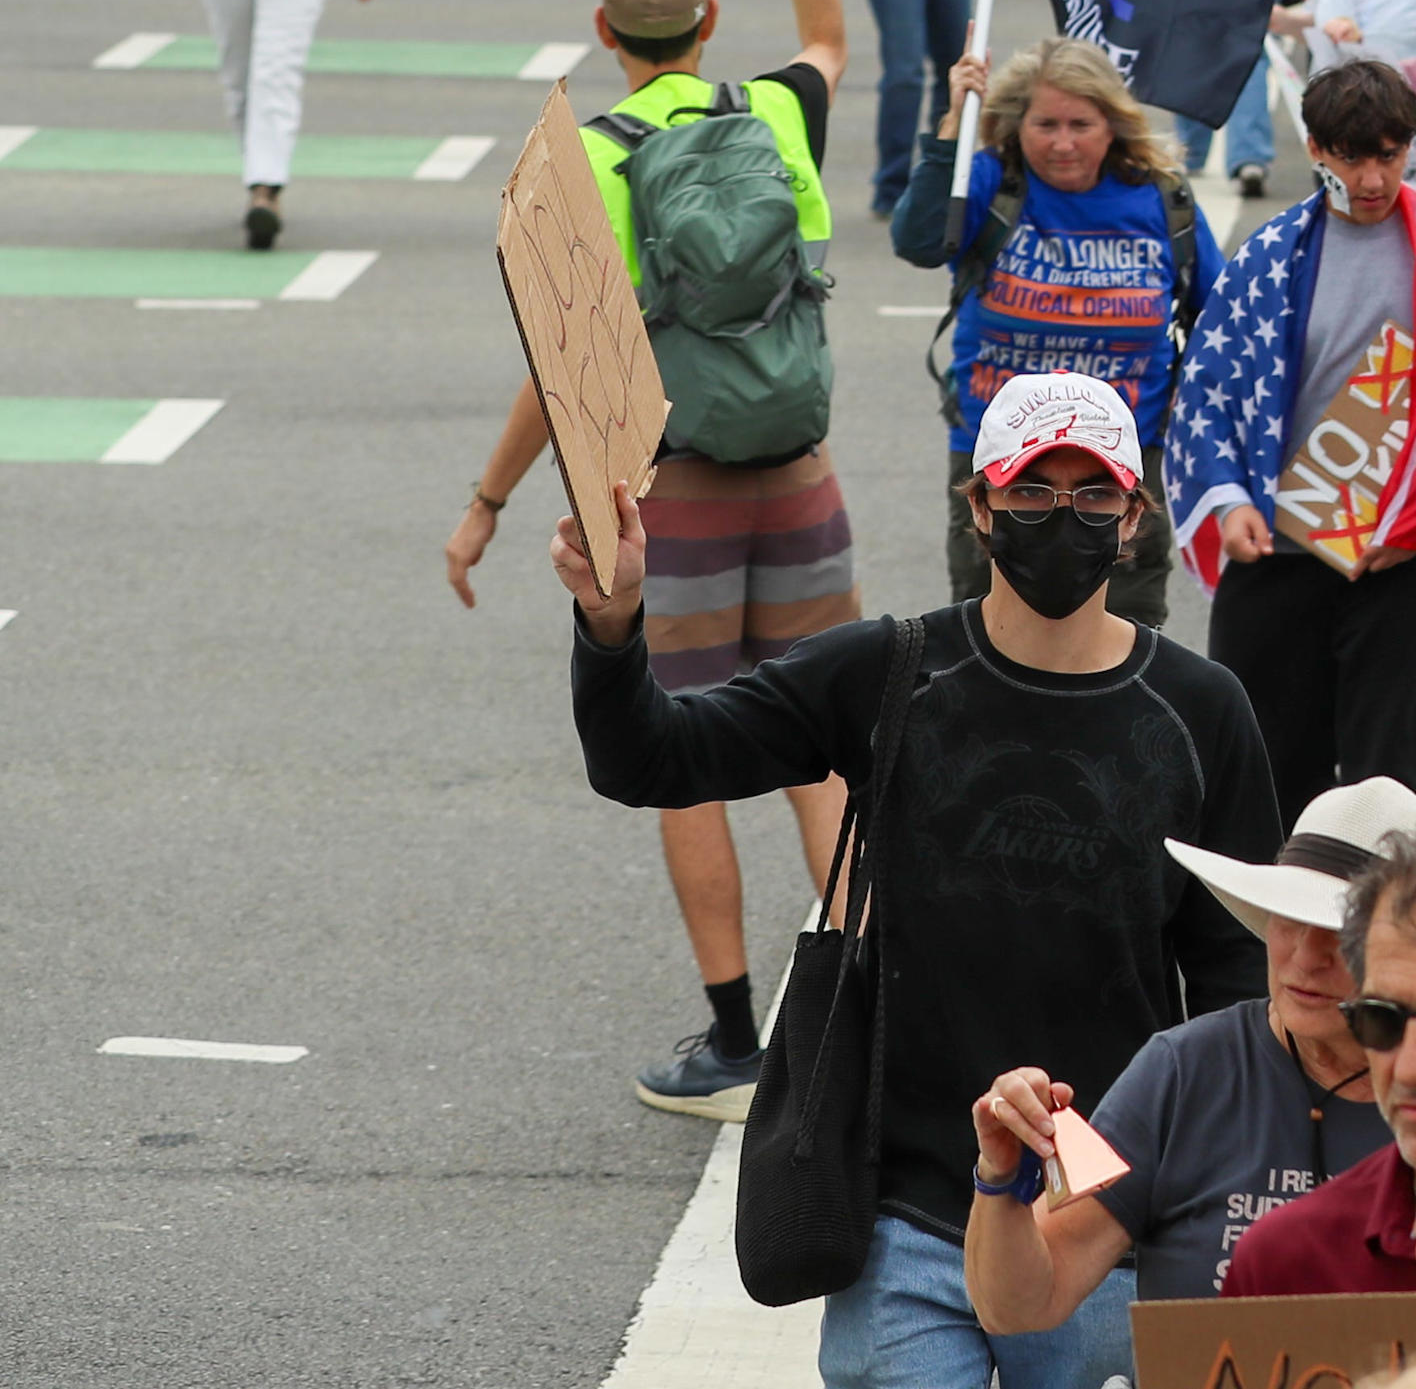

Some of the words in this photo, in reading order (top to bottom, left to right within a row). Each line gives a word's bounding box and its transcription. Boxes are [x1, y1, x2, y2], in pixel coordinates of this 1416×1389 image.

[1033, 236, 1066, 267] NO
[1067, 237, 1165, 270] LONGER
[1031, 266, 1044, 283] A
[1048, 268, 1141, 288] DIFFERENCE
[1012, 332, 1042, 347] WE
[1044, 335, 1090, 351] HAVE
[1093, 338, 1105, 351] A
[978, 339, 1125, 379] DIFFERENCE
[1275, 418, 1370, 529] NO
